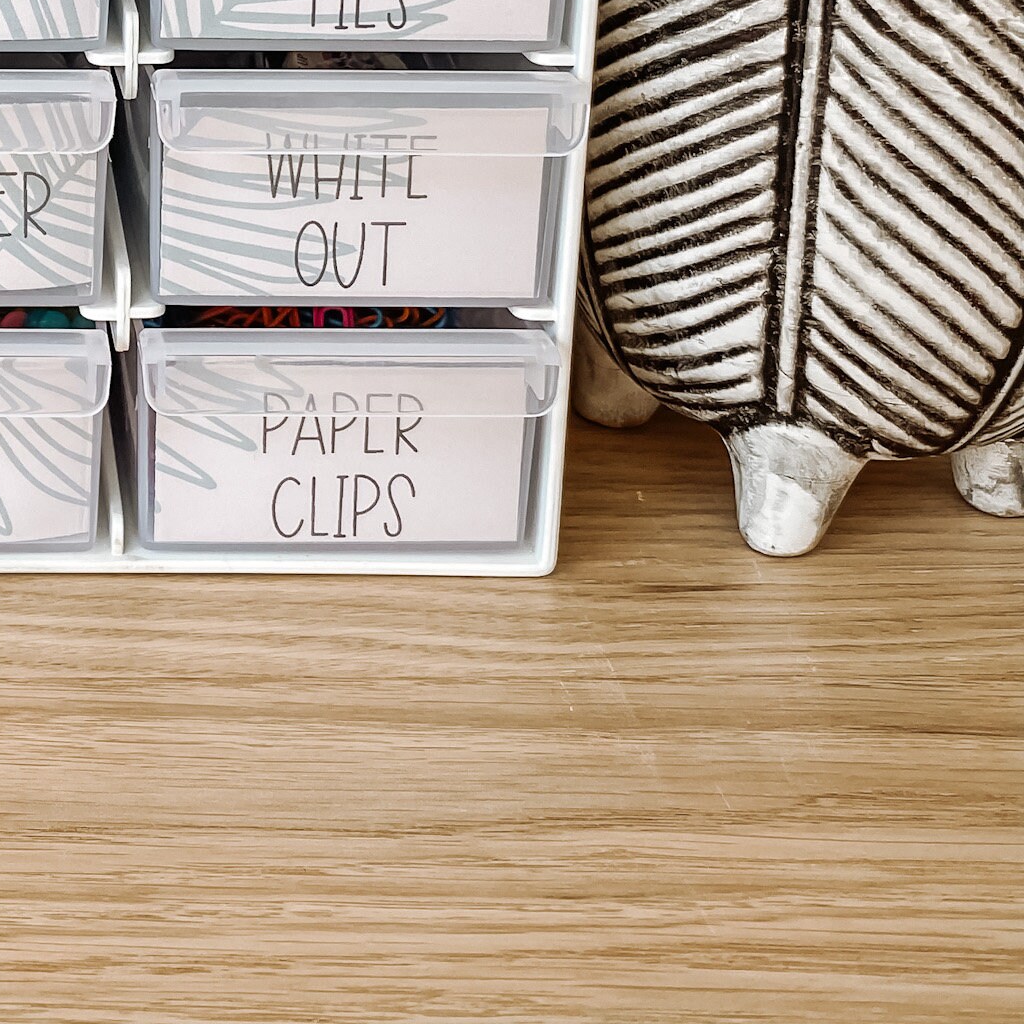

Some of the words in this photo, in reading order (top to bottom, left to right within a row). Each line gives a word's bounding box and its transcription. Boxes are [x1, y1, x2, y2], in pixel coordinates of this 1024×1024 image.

[266, 133, 437, 200] WHITE
[295, 220, 407, 288] OUT
[262, 392, 425, 455] PAPER
[272, 473, 416, 539] CLIPS
